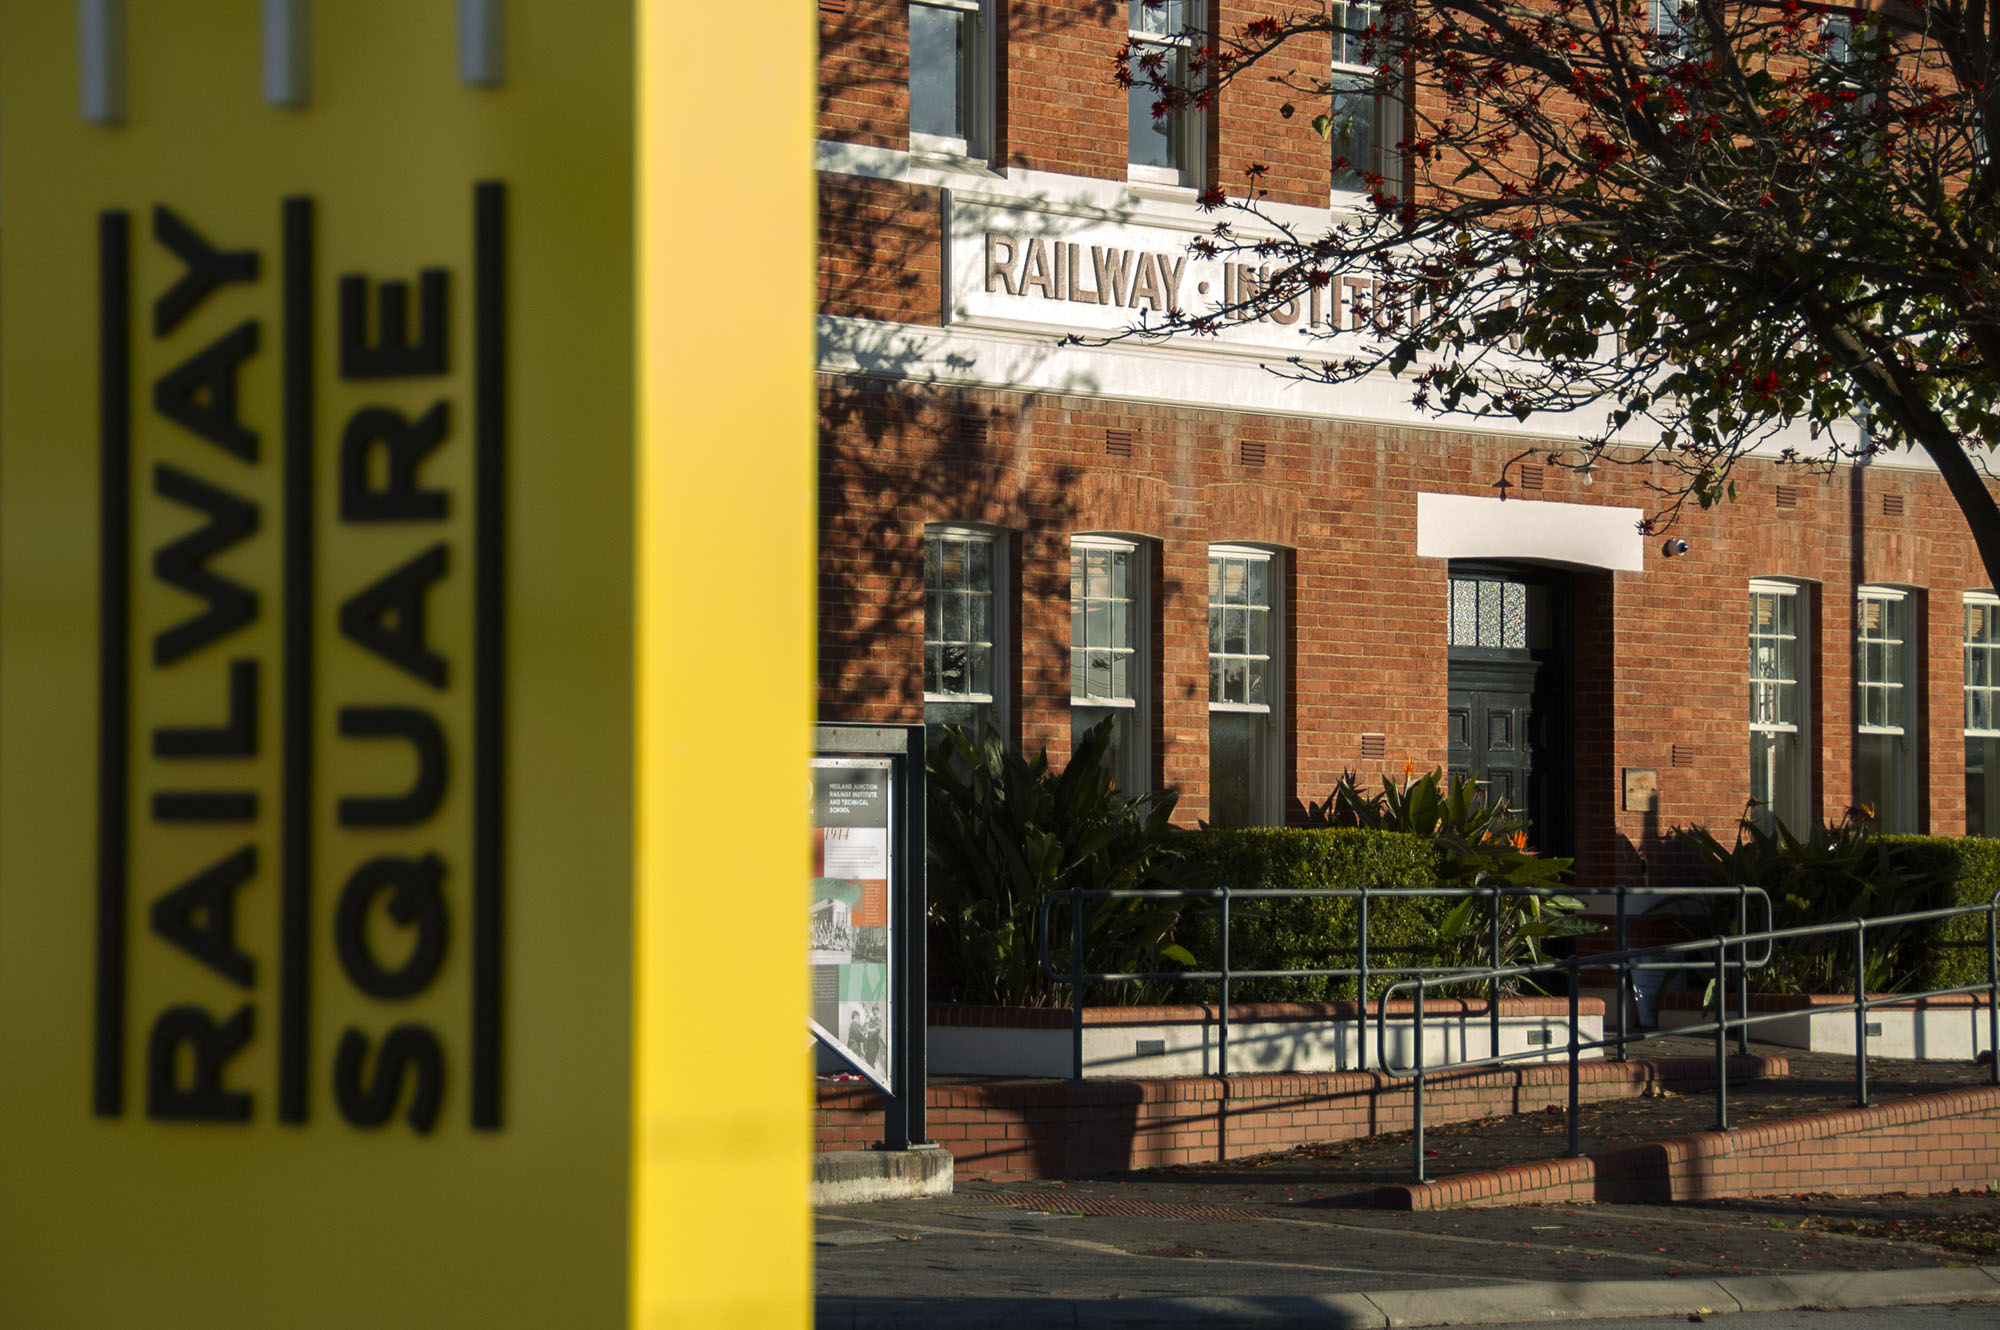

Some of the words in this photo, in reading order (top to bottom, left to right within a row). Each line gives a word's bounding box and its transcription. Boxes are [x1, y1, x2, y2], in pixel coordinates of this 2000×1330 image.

[145, 203, 262, 1127] RAILWAY
[332, 267, 452, 1138] SQUARE
[985, 232, 1187, 312] RAILWAY
[1224, 262, 1454, 341] INSTITU
